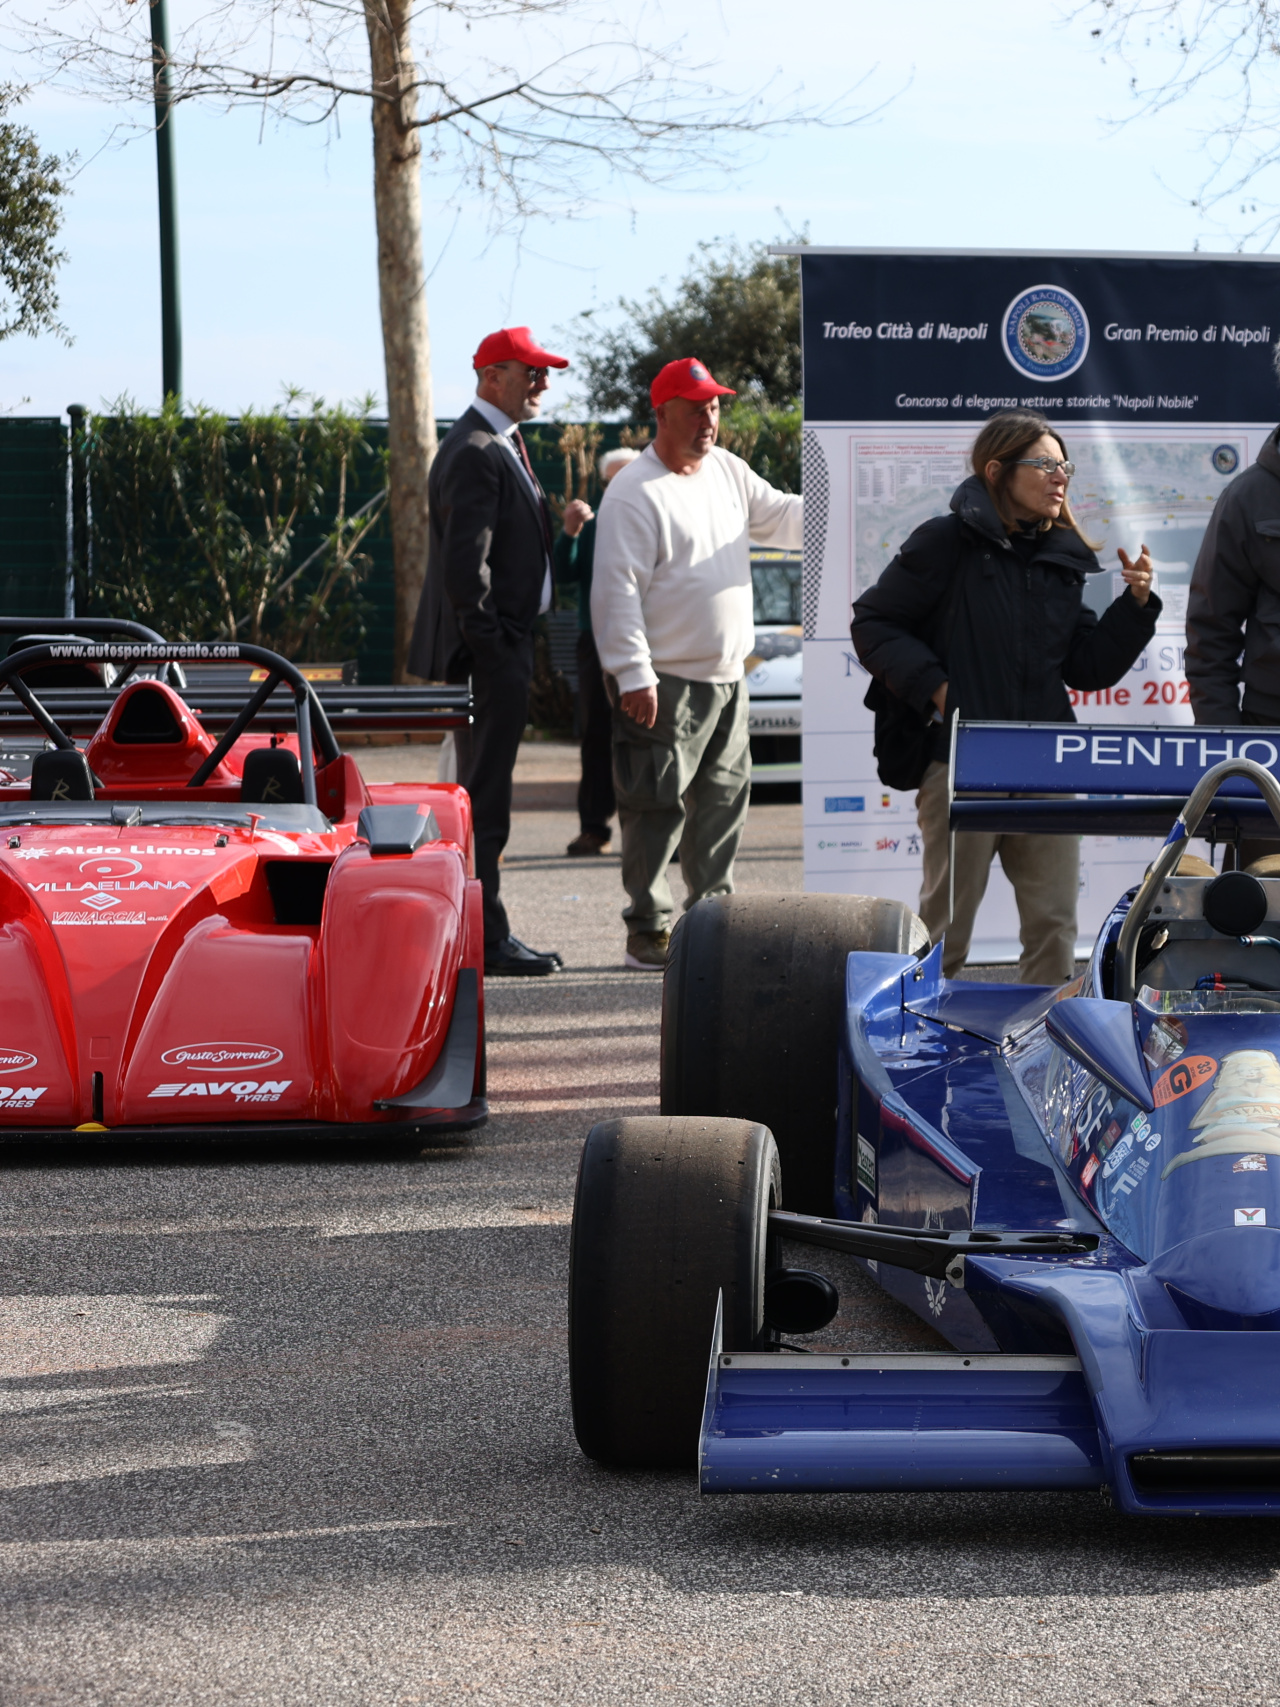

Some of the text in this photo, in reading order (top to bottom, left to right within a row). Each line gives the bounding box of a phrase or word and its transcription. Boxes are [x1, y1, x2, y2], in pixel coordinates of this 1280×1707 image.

[1009, 292, 1085, 337] NAPOLI RACING SHOW
[823, 321, 988, 343] Trofeo Città di Napoli
[1104, 322, 1270, 347] Gran Premio di Napoli
[896, 393, 1199, 412] Concorso di eleganza vetture storiche "Napoli Nobile"
[49, 643, 240, 661] www.autosportsorrento.com
[54, 844, 217, 856] Aldo Limos
[875, 836, 901, 854] sky
[1197, 1061, 1212, 1075] 33
[1170, 1064, 1192, 1094] G
[179, 1080, 293, 1097] AVON
[234, 1093, 281, 1103] TYRES
